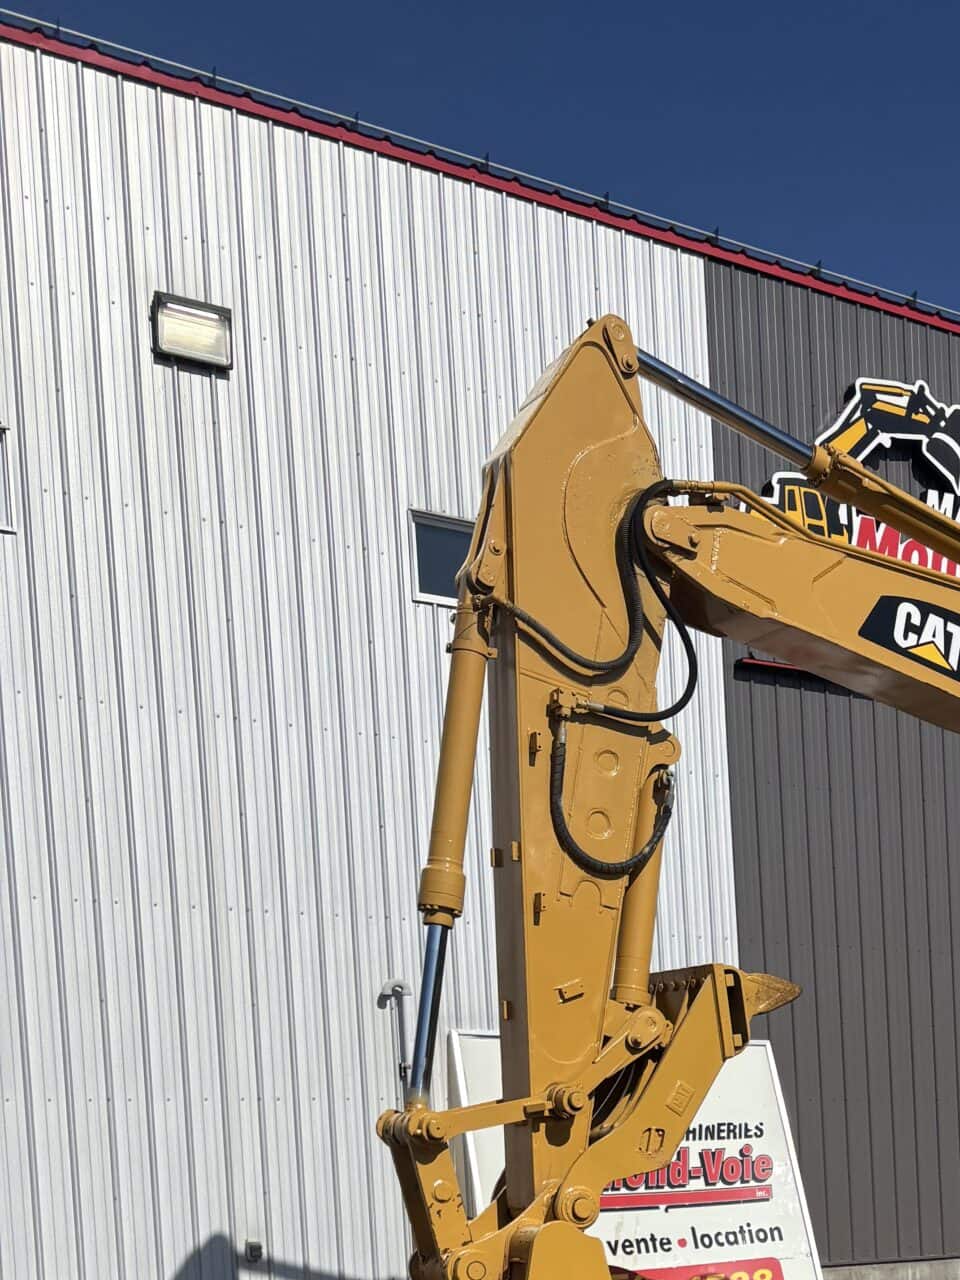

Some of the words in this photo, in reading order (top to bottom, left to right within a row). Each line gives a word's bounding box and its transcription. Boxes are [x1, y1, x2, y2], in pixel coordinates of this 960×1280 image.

[685, 1122, 764, 1142] HINERIES
[606, 1232, 673, 1256] vente
[690, 1222, 784, 1249] location
